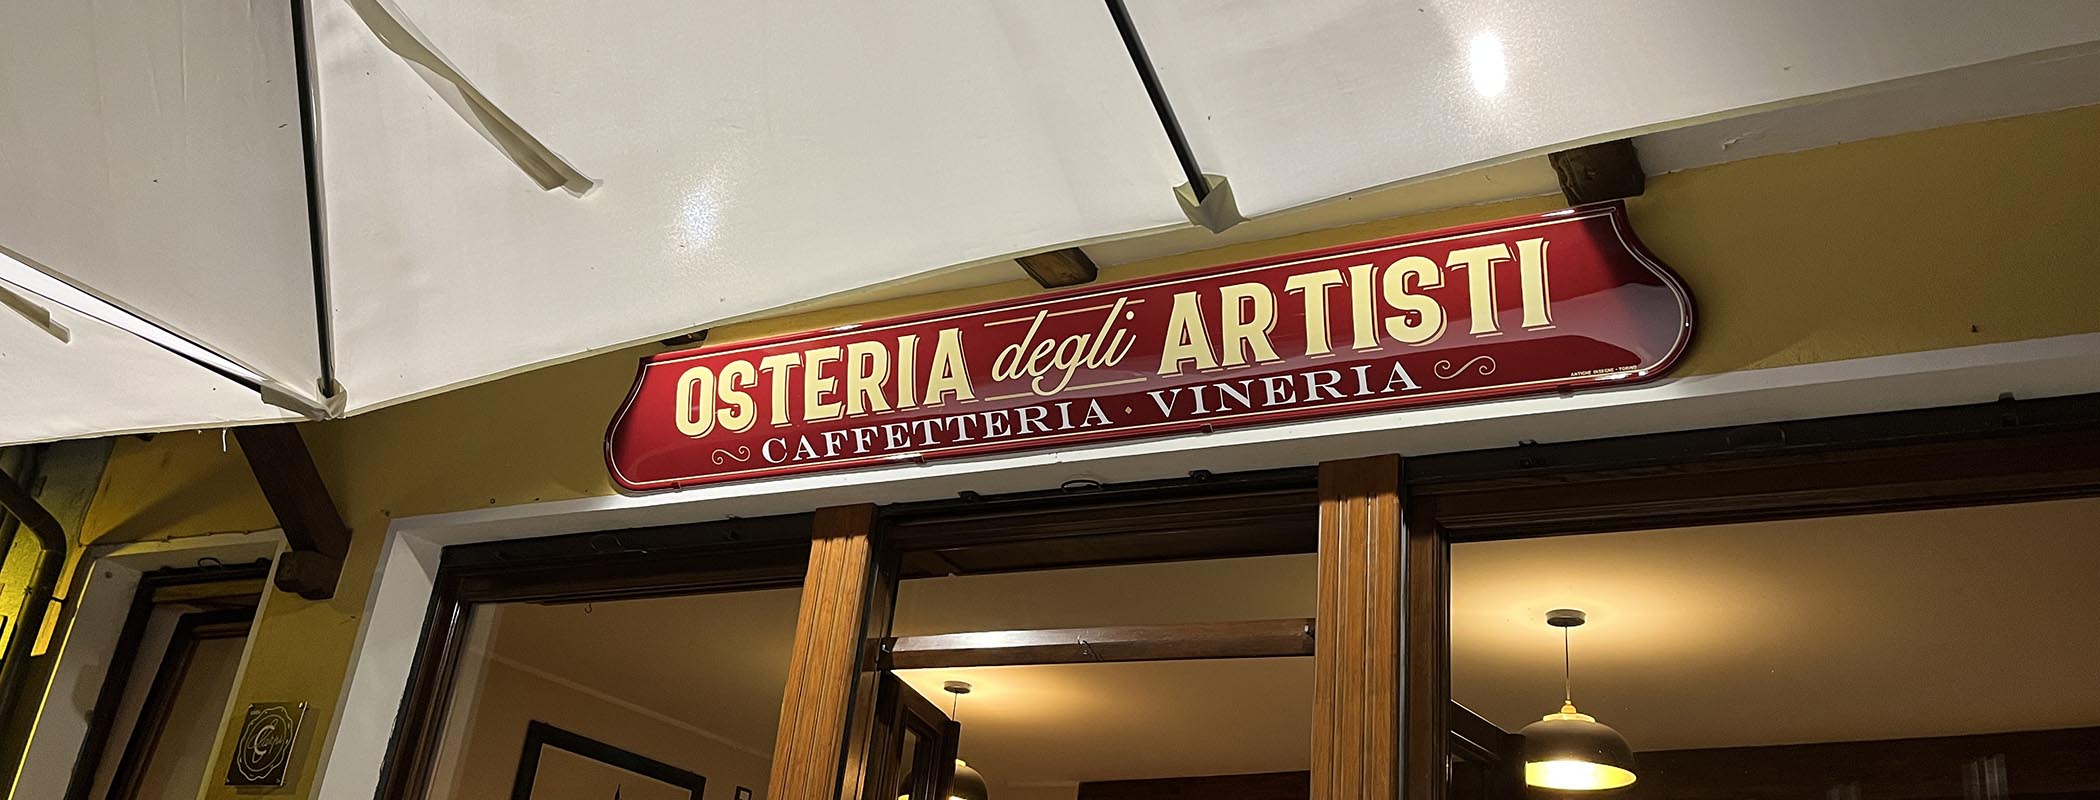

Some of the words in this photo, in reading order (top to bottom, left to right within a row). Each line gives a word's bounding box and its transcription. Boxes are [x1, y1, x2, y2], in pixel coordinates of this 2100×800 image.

[675, 327, 978, 439] OSTERIA
[992, 296, 1138, 397] degli
[1157, 237, 1556, 375] ARTISTI
[761, 398, 1114, 464] CAFFETTERIA
[1147, 361, 1422, 419] VINERIA
